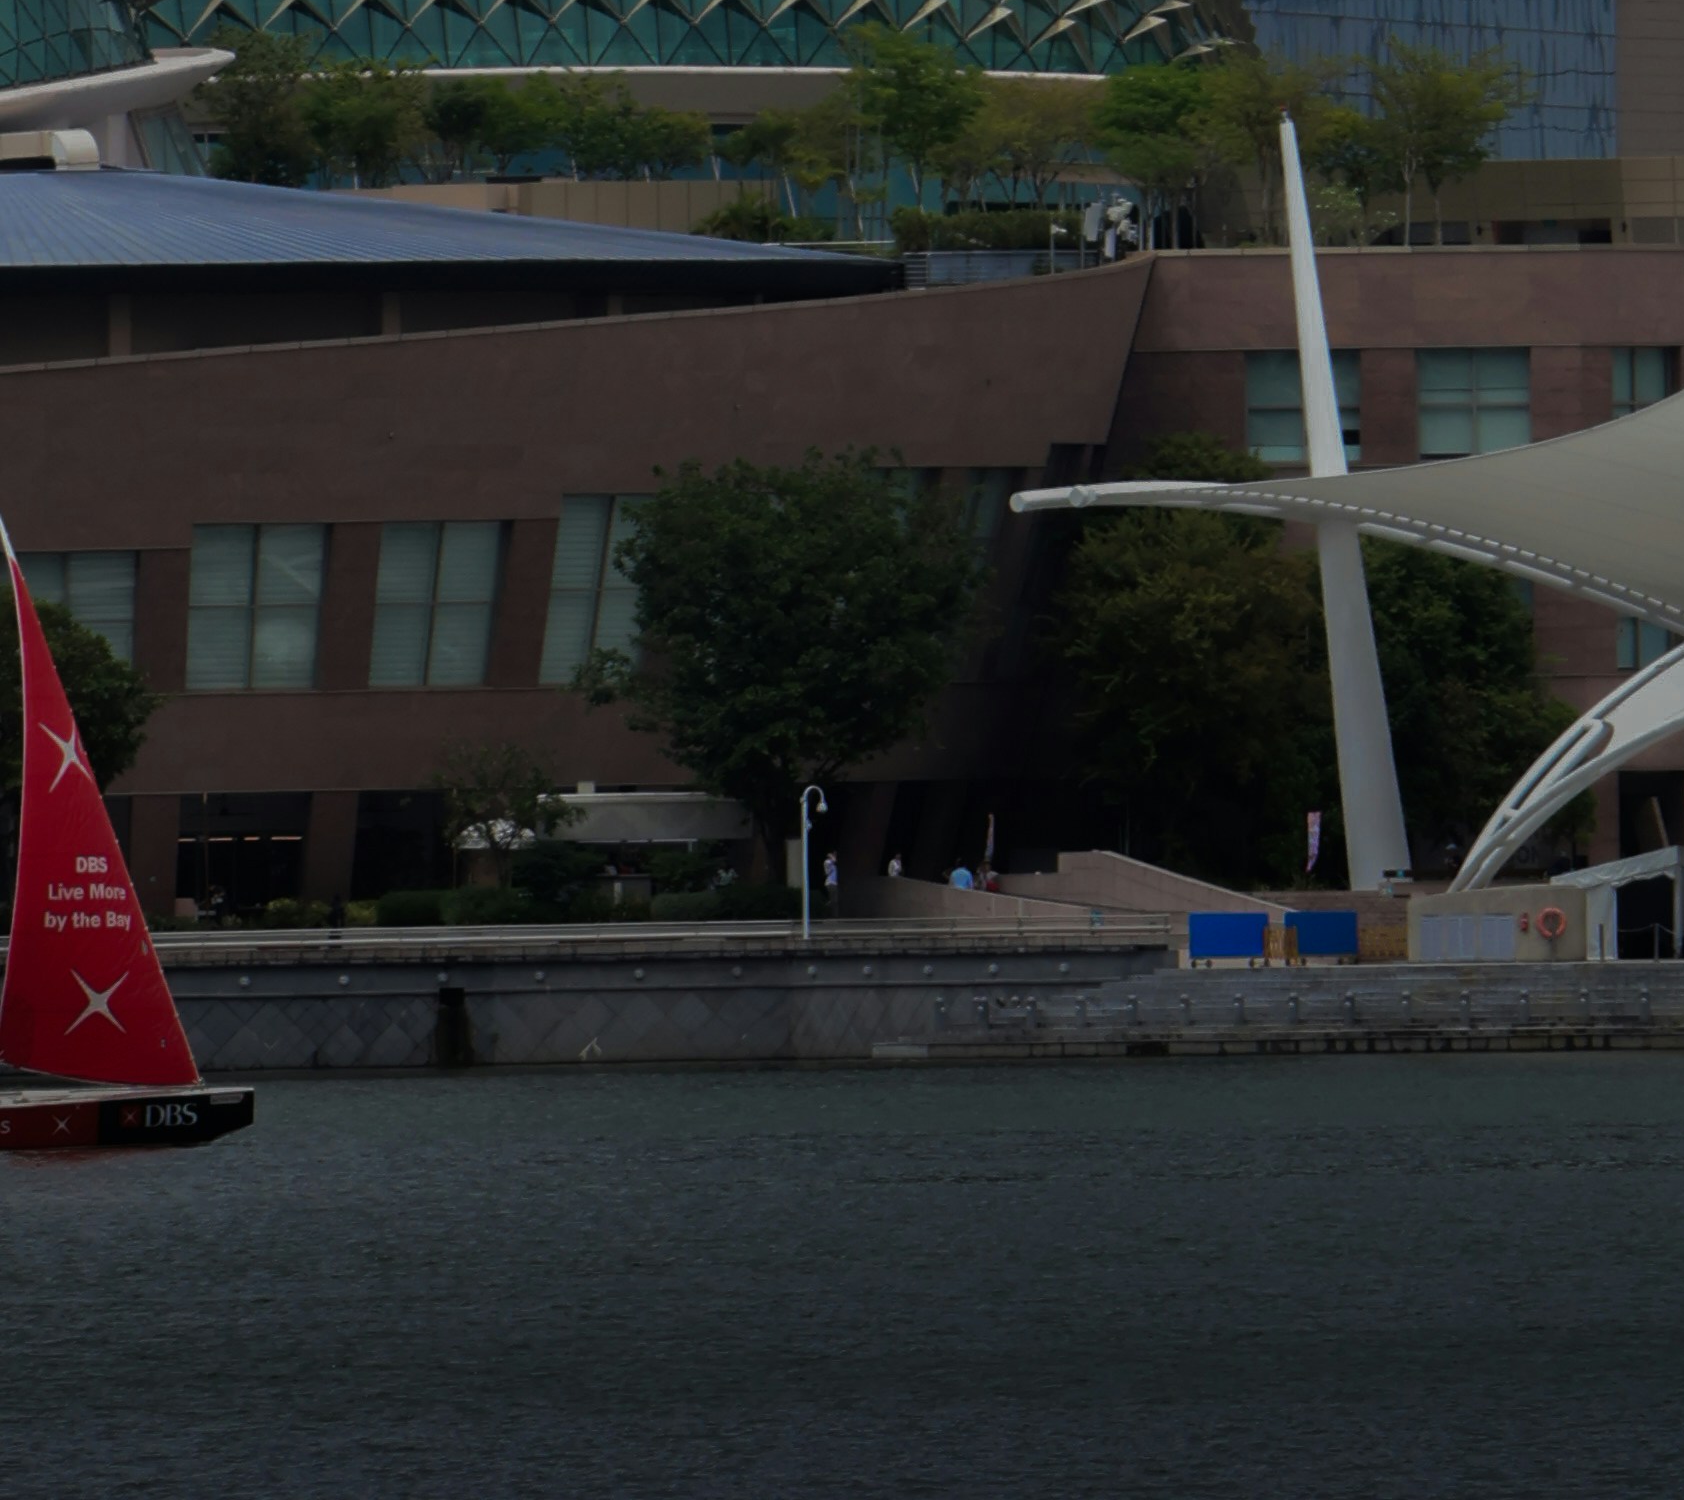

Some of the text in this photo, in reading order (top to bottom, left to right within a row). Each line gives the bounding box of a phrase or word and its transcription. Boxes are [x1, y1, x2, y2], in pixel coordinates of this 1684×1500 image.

[75, 856, 109, 874] DBS
[48, 883, 127, 901] Live More
[44, 911, 132, 933] by the Bay
[144, 1103, 199, 1128] DBS
